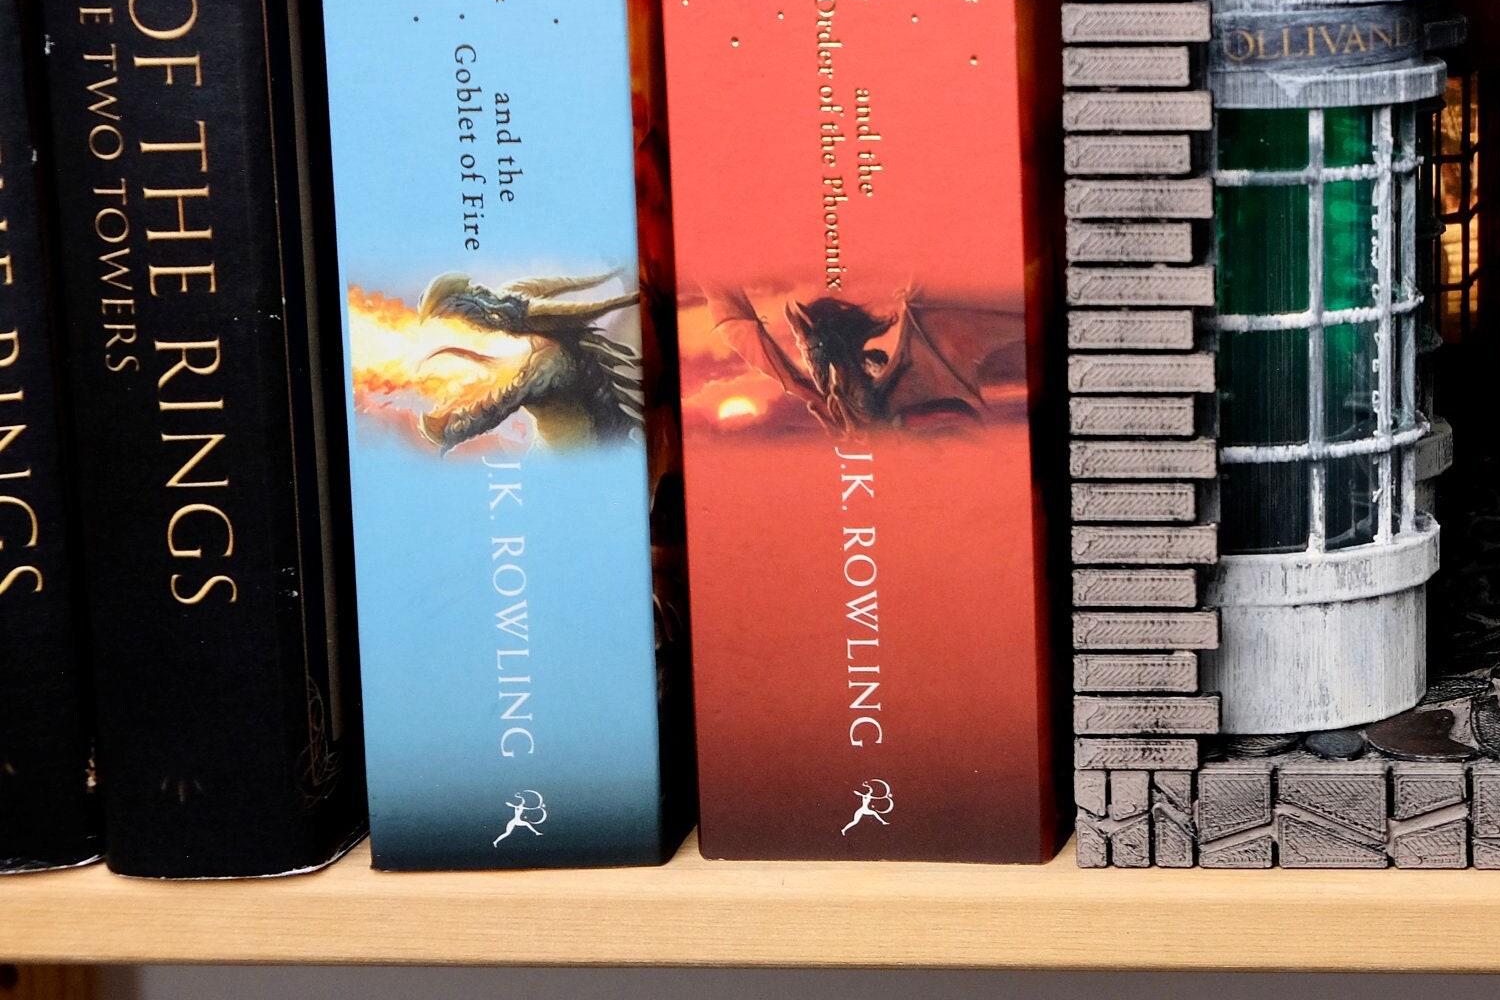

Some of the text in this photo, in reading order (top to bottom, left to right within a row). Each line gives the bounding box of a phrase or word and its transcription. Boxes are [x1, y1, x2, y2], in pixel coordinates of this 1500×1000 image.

[83, 43, 124, 160] TWO
[454, 44, 486, 250] Goblet of Fire
[494, 92, 523, 202] and the
[818, 85, 844, 117] of
[820, 121, 846, 167] the
[855, 88, 883, 197] and the
[93, 178, 139, 373] TOWERS
[140, 120, 216, 297] THE
[822, 175, 848, 291] Phoenix
[154, 337, 237, 605] RINGS
[482, 456, 535, 758] J.K. ROWLING
[834, 447, 883, 748] J.K. ROWLING
